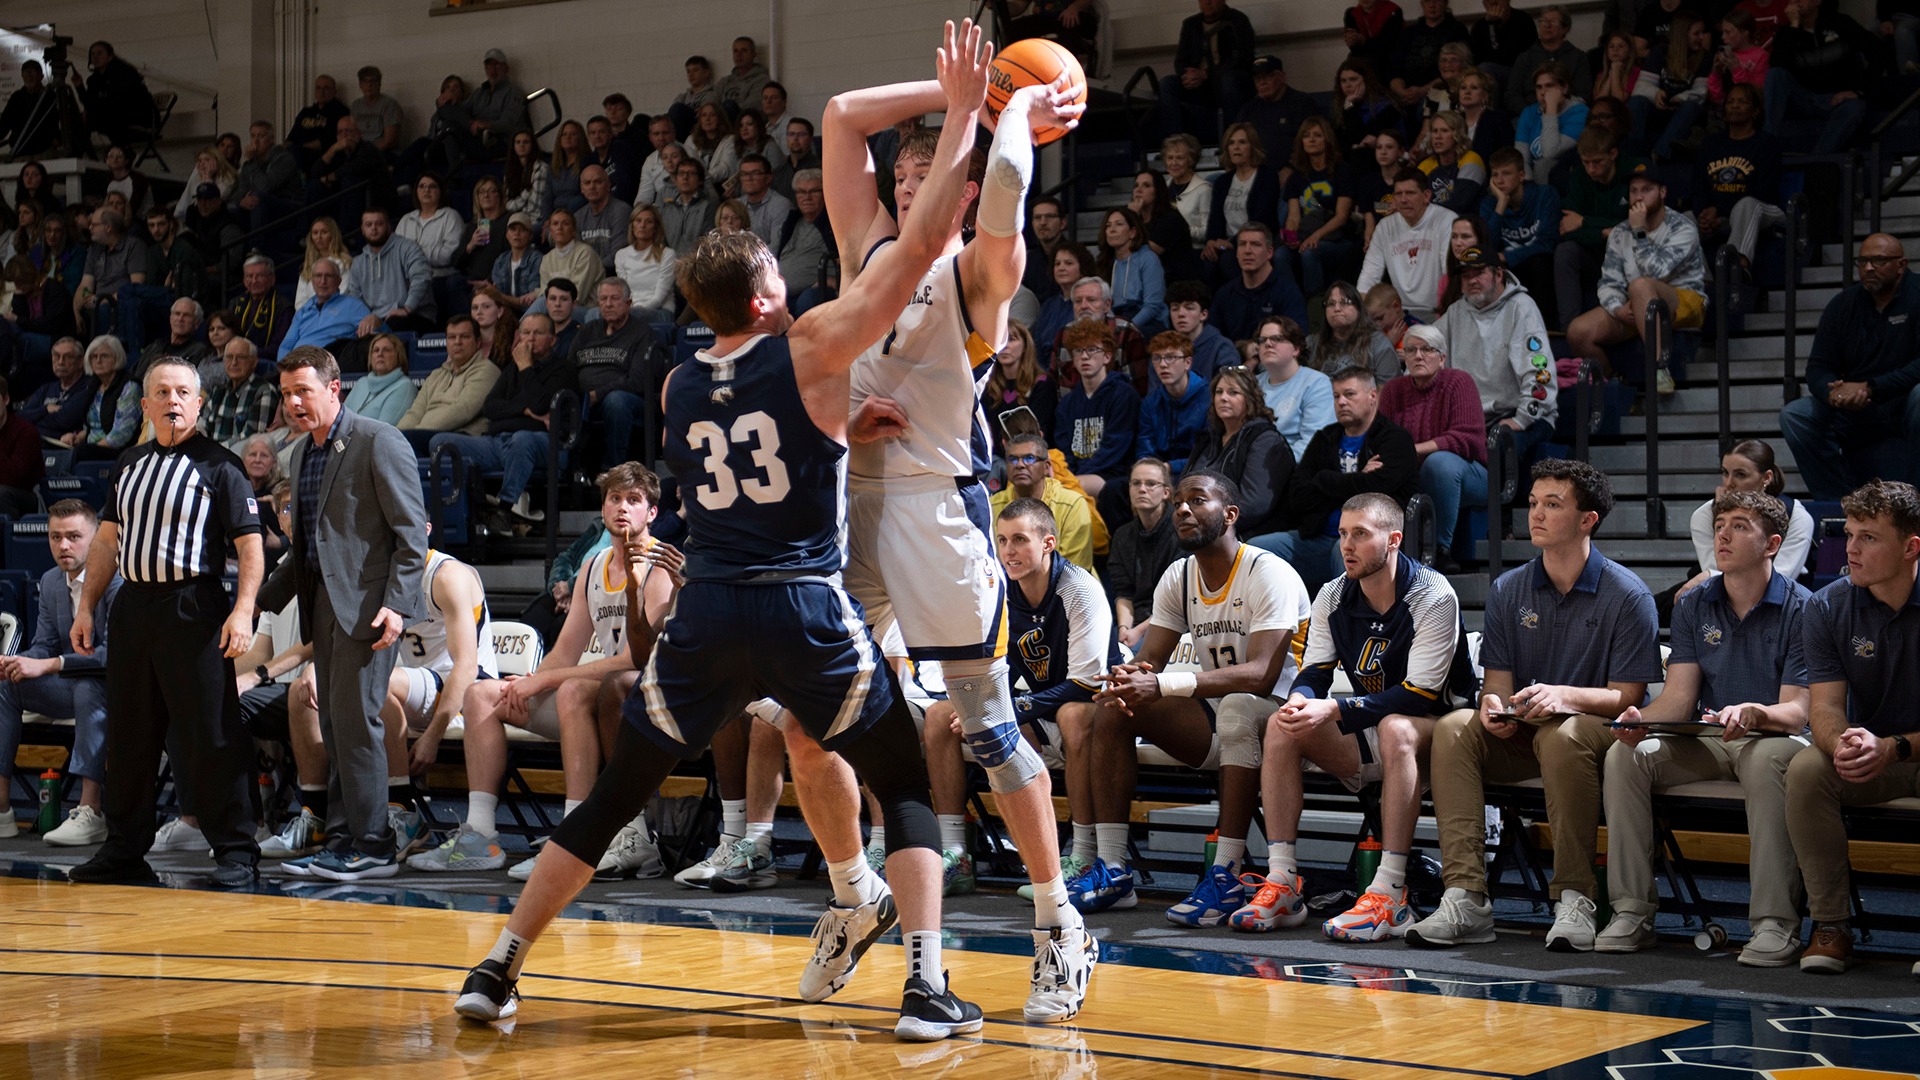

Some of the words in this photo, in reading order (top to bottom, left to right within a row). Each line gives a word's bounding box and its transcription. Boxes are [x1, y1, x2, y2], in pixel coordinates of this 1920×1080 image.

[687, 327, 716, 336] RESER
[417, 338, 447, 348] RESERV
[685, 410, 792, 511] 33
[47, 479, 82, 489] RESERVED
[13, 523, 49, 533] RESERVE
[492, 633, 531, 656] KETS
[1208, 644, 1240, 670] 13
